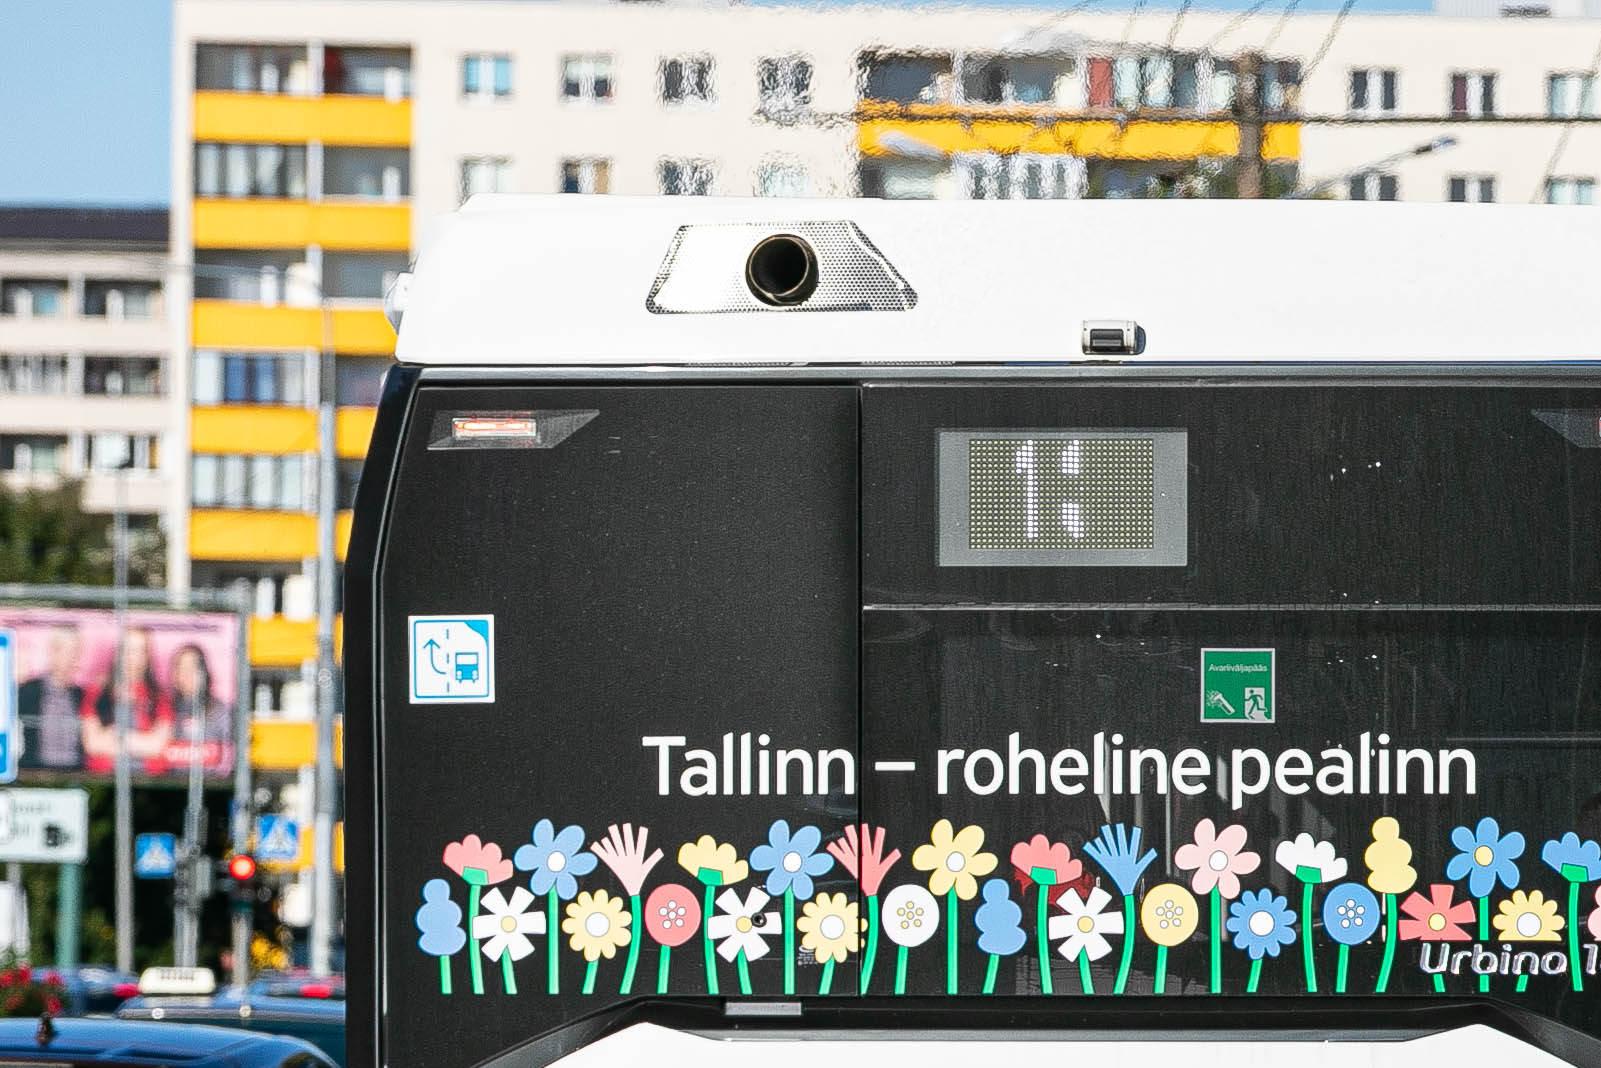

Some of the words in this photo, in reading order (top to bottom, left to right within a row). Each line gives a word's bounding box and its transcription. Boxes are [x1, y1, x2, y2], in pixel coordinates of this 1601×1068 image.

[642, 732, 855, 796] Tallinn
[937, 732, 1211, 795] roheline
[1231, 732, 1477, 810] pealinn
[1419, 942, 1568, 975] Urbino
